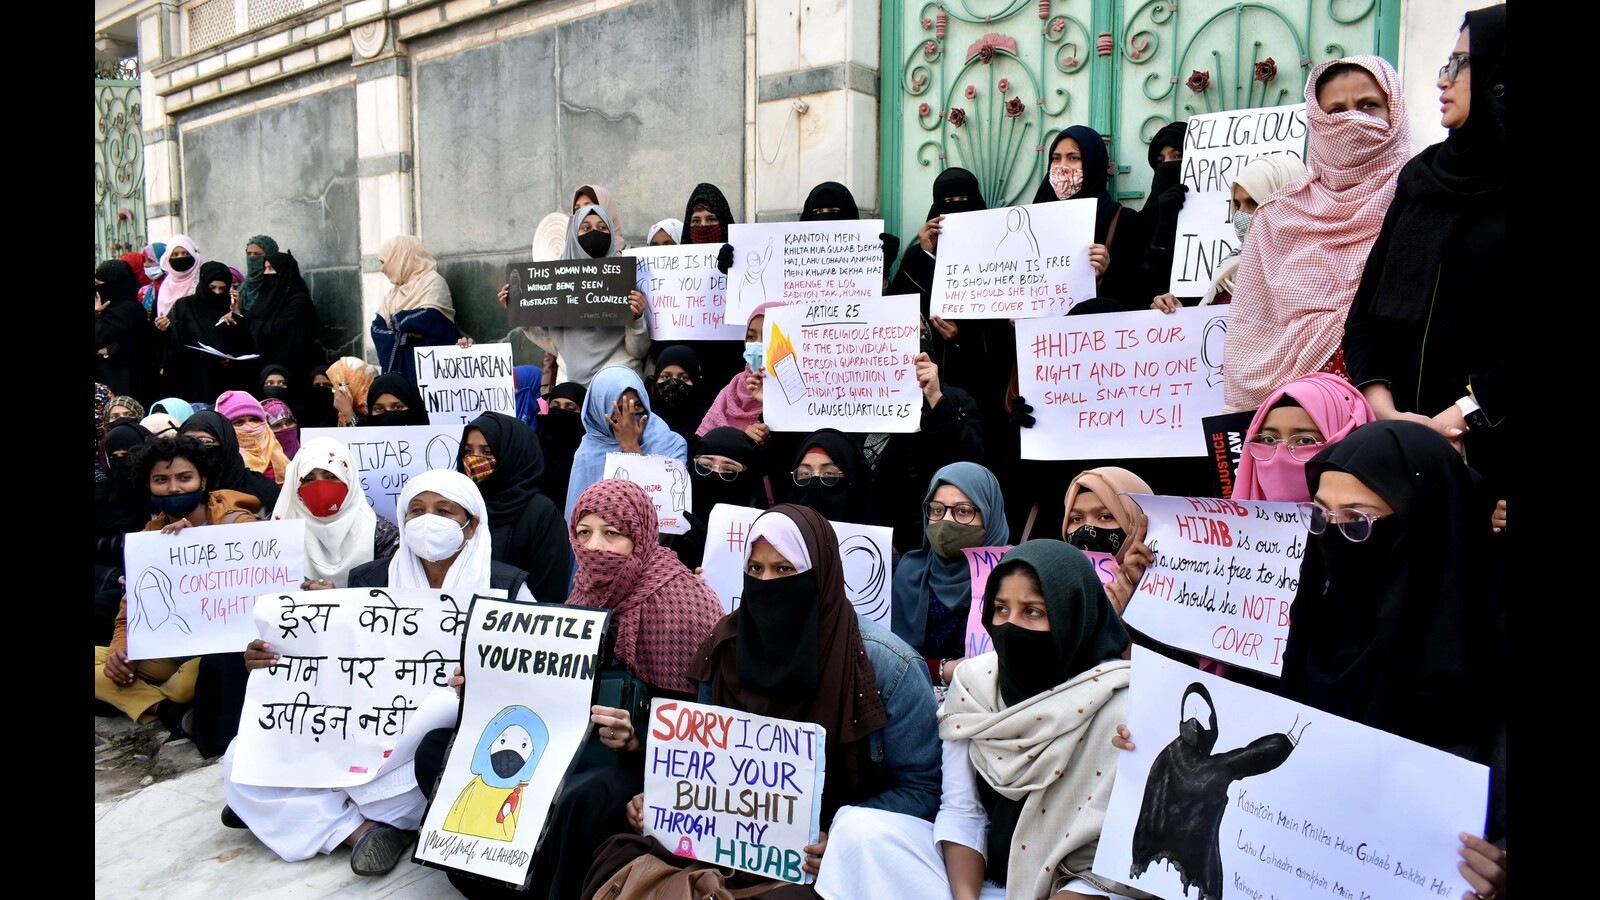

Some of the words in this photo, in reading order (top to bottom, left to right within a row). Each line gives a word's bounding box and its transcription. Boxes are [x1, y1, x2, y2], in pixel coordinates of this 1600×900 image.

[1184, 109, 1306, 151] RELIGIOUS
[1181, 150, 1302, 193] APART
[834, 233, 860, 243] MEIN
[810, 246, 826, 255] HUA
[857, 243, 882, 252] DEKHA
[850, 255, 882, 264] ANKHON
[527, 267, 550, 279] THIS
[554, 265, 580, 275] WOMAN
[581, 265, 598, 274] WHO
[602, 263, 621, 274] SEES
[636, 255, 680, 272] #HIJAB
[684, 254, 700, 270] IS
[784, 269, 803, 278] MEIN
[946, 264, 959, 276] IF
[963, 264, 971, 274] A
[979, 260, 1018, 274] WOMAN
[1025, 259, 1041, 272] IS
[1046, 255, 1071, 269] FREE
[527, 283, 552, 292] WITHOUT
[556, 281, 575, 291] BEING
[651, 278, 666, 291] IF
[679, 277, 702, 291] YOU
[784, 280, 822, 289] KAHENGE
[825, 280, 835, 288] YE
[838, 279, 856, 288] LOG
[945, 289, 967, 301] WHY
[970, 288, 1004, 299] SHOULD
[1008, 286, 1025, 296] SHE
[1030, 285, 1049, 296] NOT
[1055, 283, 1069, 294] BE
[946, 279, 959, 289] TO
[962, 276, 992, 287] SHOW
[994, 275, 1014, 286] HER
[519, 297, 558, 307] FRUSTRATES
[565, 294, 579, 305] THE
[652, 295, 680, 308] UNTIL
[686, 296, 707, 309] THE
[783, 290, 818, 298] SADIYON
[805, 305, 839, 322] ARTICLE
[845, 304, 860, 318] 25
[942, 303, 964, 314] FREE
[970, 303, 986, 313] TO
[991, 301, 1023, 312] COVER
[653, 312, 659, 330] I
[672, 314, 695, 328] WILL
[801, 328, 821, 340] THE
[822, 328, 870, 341] RELIGIOUS
[872, 325, 919, 341] FREEDOM
[1031, 330, 1107, 358] #HIJAB
[1114, 328, 1140, 350] IS
[1147, 327, 1186, 344] OUR
[802, 343, 811, 352] OF
[814, 343, 832, 354] THE
[836, 343, 897, 355] INDIVIDUAL
[802, 356, 837, 369] PERSON
[839, 355, 899, 367] GUARANTEED
[903, 354, 916, 365] BY
[1035, 363, 1081, 385] RIGHT
[1089, 362, 1126, 385] AND
[1134, 361, 1160, 378] NO
[1164, 357, 1198, 376] ONE
[802, 372, 821, 384] THE
[894, 369, 907, 381] OF
[419, 384, 515, 414] INTIMIDATION
[849, 387, 873, 401] GIVEN
[1044, 391, 1088, 405] SHALL
[1096, 383, 1161, 401] SNATCH
[1170, 382, 1193, 396] IT
[896, 403, 911, 418] 25
[1078, 408, 1124, 428] FROM
[348, 440, 412, 472] IJAB
[1212, 432, 1233, 499] INJUSTICE
[1255, 505, 1270, 521] is
[1274, 510, 1299, 523] our
[1176, 514, 1233, 548] HIJAB
[1237, 529, 1251, 550] is
[1255, 539, 1281, 554] our
[169, 543, 218, 568] HIJAB
[224, 541, 244, 562] IS
[251, 538, 281, 560] OUR
[179, 566, 299, 594] CONSTITUTIONAL
[1170, 557, 1211, 576] woman
[1213, 559, 1225, 576] is
[1227, 556, 1252, 585] free
[1257, 563, 1276, 584] to
[1140, 573, 1175, 602] WHY
[1174, 581, 1216, 612] should
[1218, 591, 1238, 615] she
[1242, 594, 1276, 624] NOT
[278, 595, 340, 639] ड्रेस
[358, 589, 423, 636] कोड
[482, 609, 595, 640] SANITIZE
[1211, 625, 1263, 661] COVER
[268, 655, 328, 686] नाम
[337, 656, 386, 688] पर
[652, 702, 734, 750] SORRY
[735, 717, 753, 750] I
[756, 722, 816, 761] CAN'T
[652, 746, 717, 785] HEAR
[728, 755, 803, 794] YOUR
[672, 780, 798, 825] BULLSHIT
[649, 805, 716, 842] THROGH
[735, 820, 769, 845] MY
[1237, 829, 1258, 857] Lahu
[480, 846, 530, 868] ALLAHABAD
[714, 836, 801, 882] HIJAB
[1277, 811, 1299, 833] Mein
[1301, 819, 1332, 846] Khilta
[1334, 836, 1354, 855] Hua
[1356, 842, 1391, 871] Gulaab
[1393, 862, 1427, 888] Dekha
[1430, 878, 1454, 898] Hai
